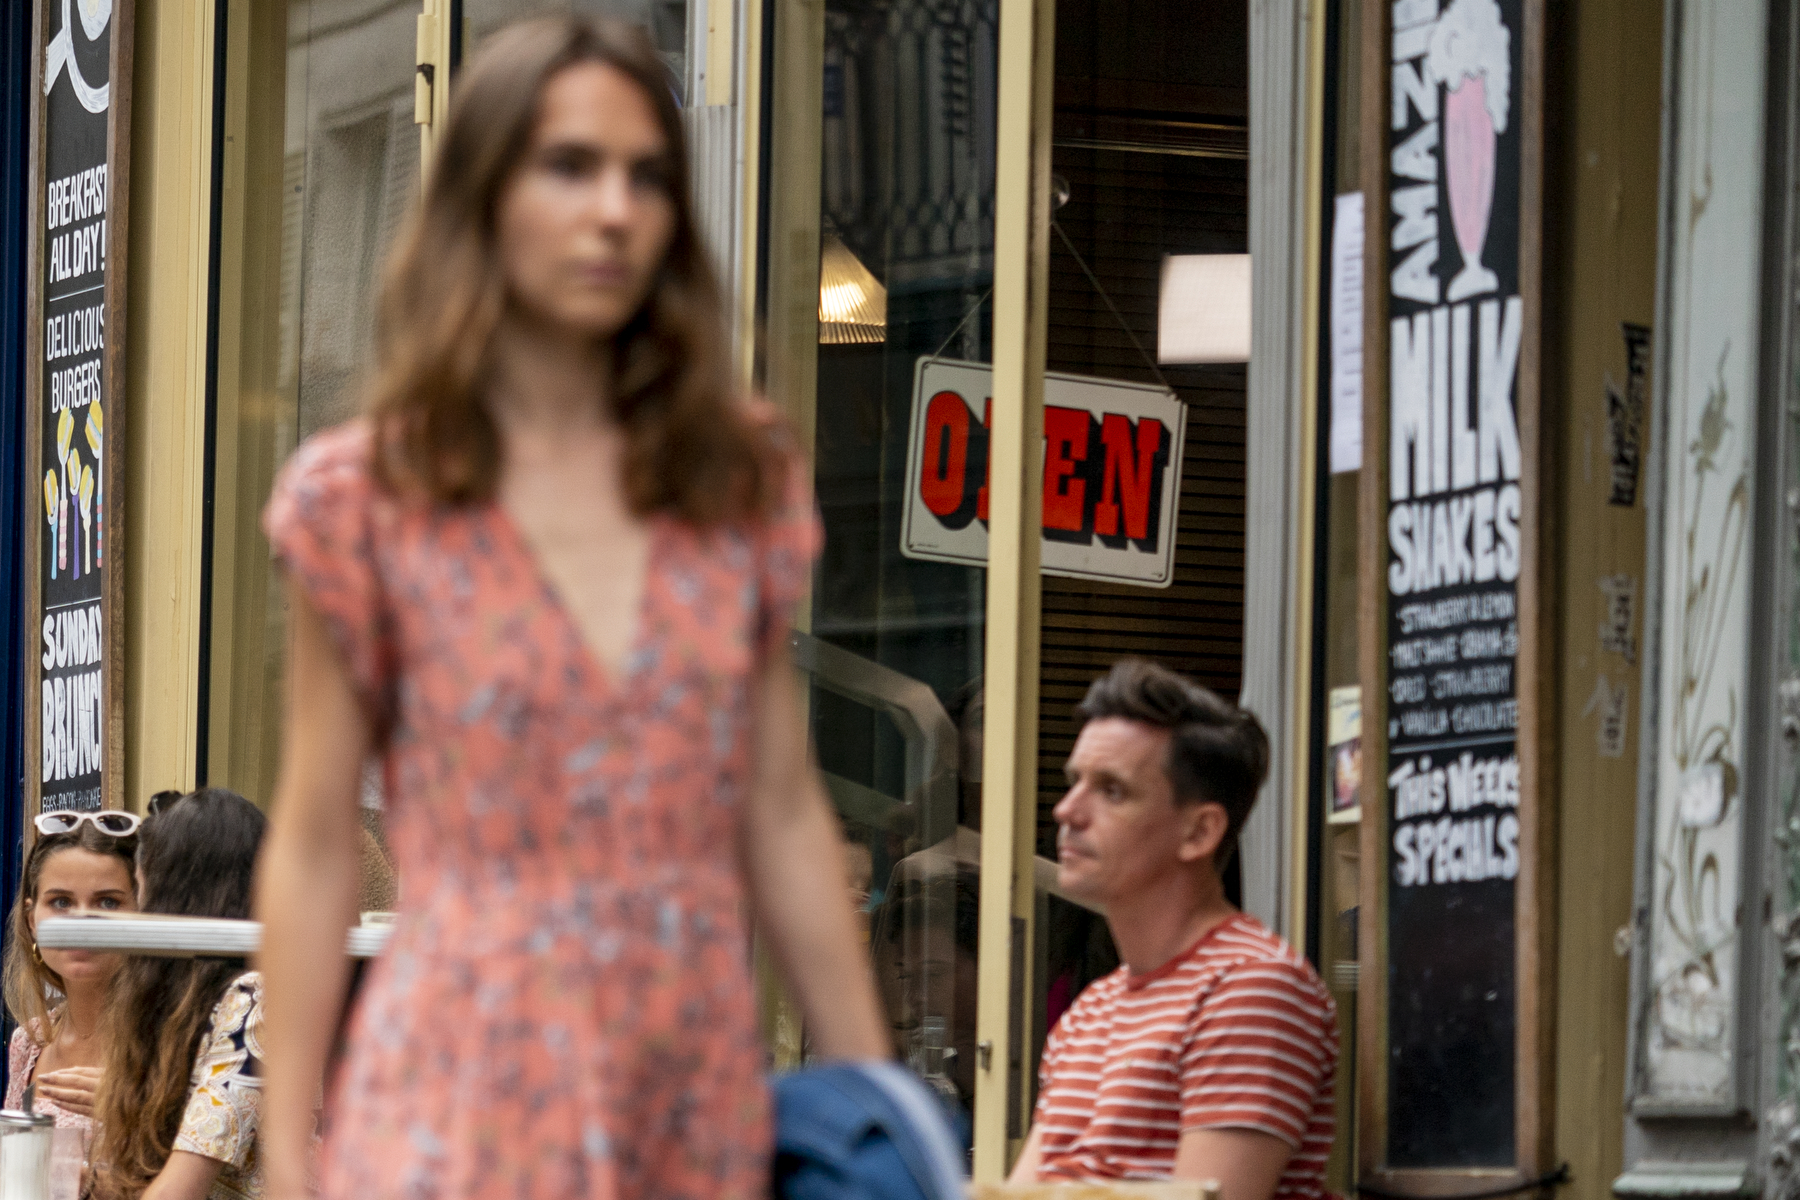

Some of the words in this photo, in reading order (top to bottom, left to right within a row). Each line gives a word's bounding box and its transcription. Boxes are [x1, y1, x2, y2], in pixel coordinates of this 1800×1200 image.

[48, 164, 107, 230] BREAKFAST
[50, 233, 71, 283] ALL
[46, 303, 104, 362] DELICIOUS
[51, 359, 100, 414] BURGERS
[1390, 296, 1523, 500] MILK
[920, 391, 1170, 553] OEN
[1388, 484, 1521, 595] SHAKES
[42, 605, 102, 671] SUNDAY
[1393, 812, 1520, 887] SPECIALS
